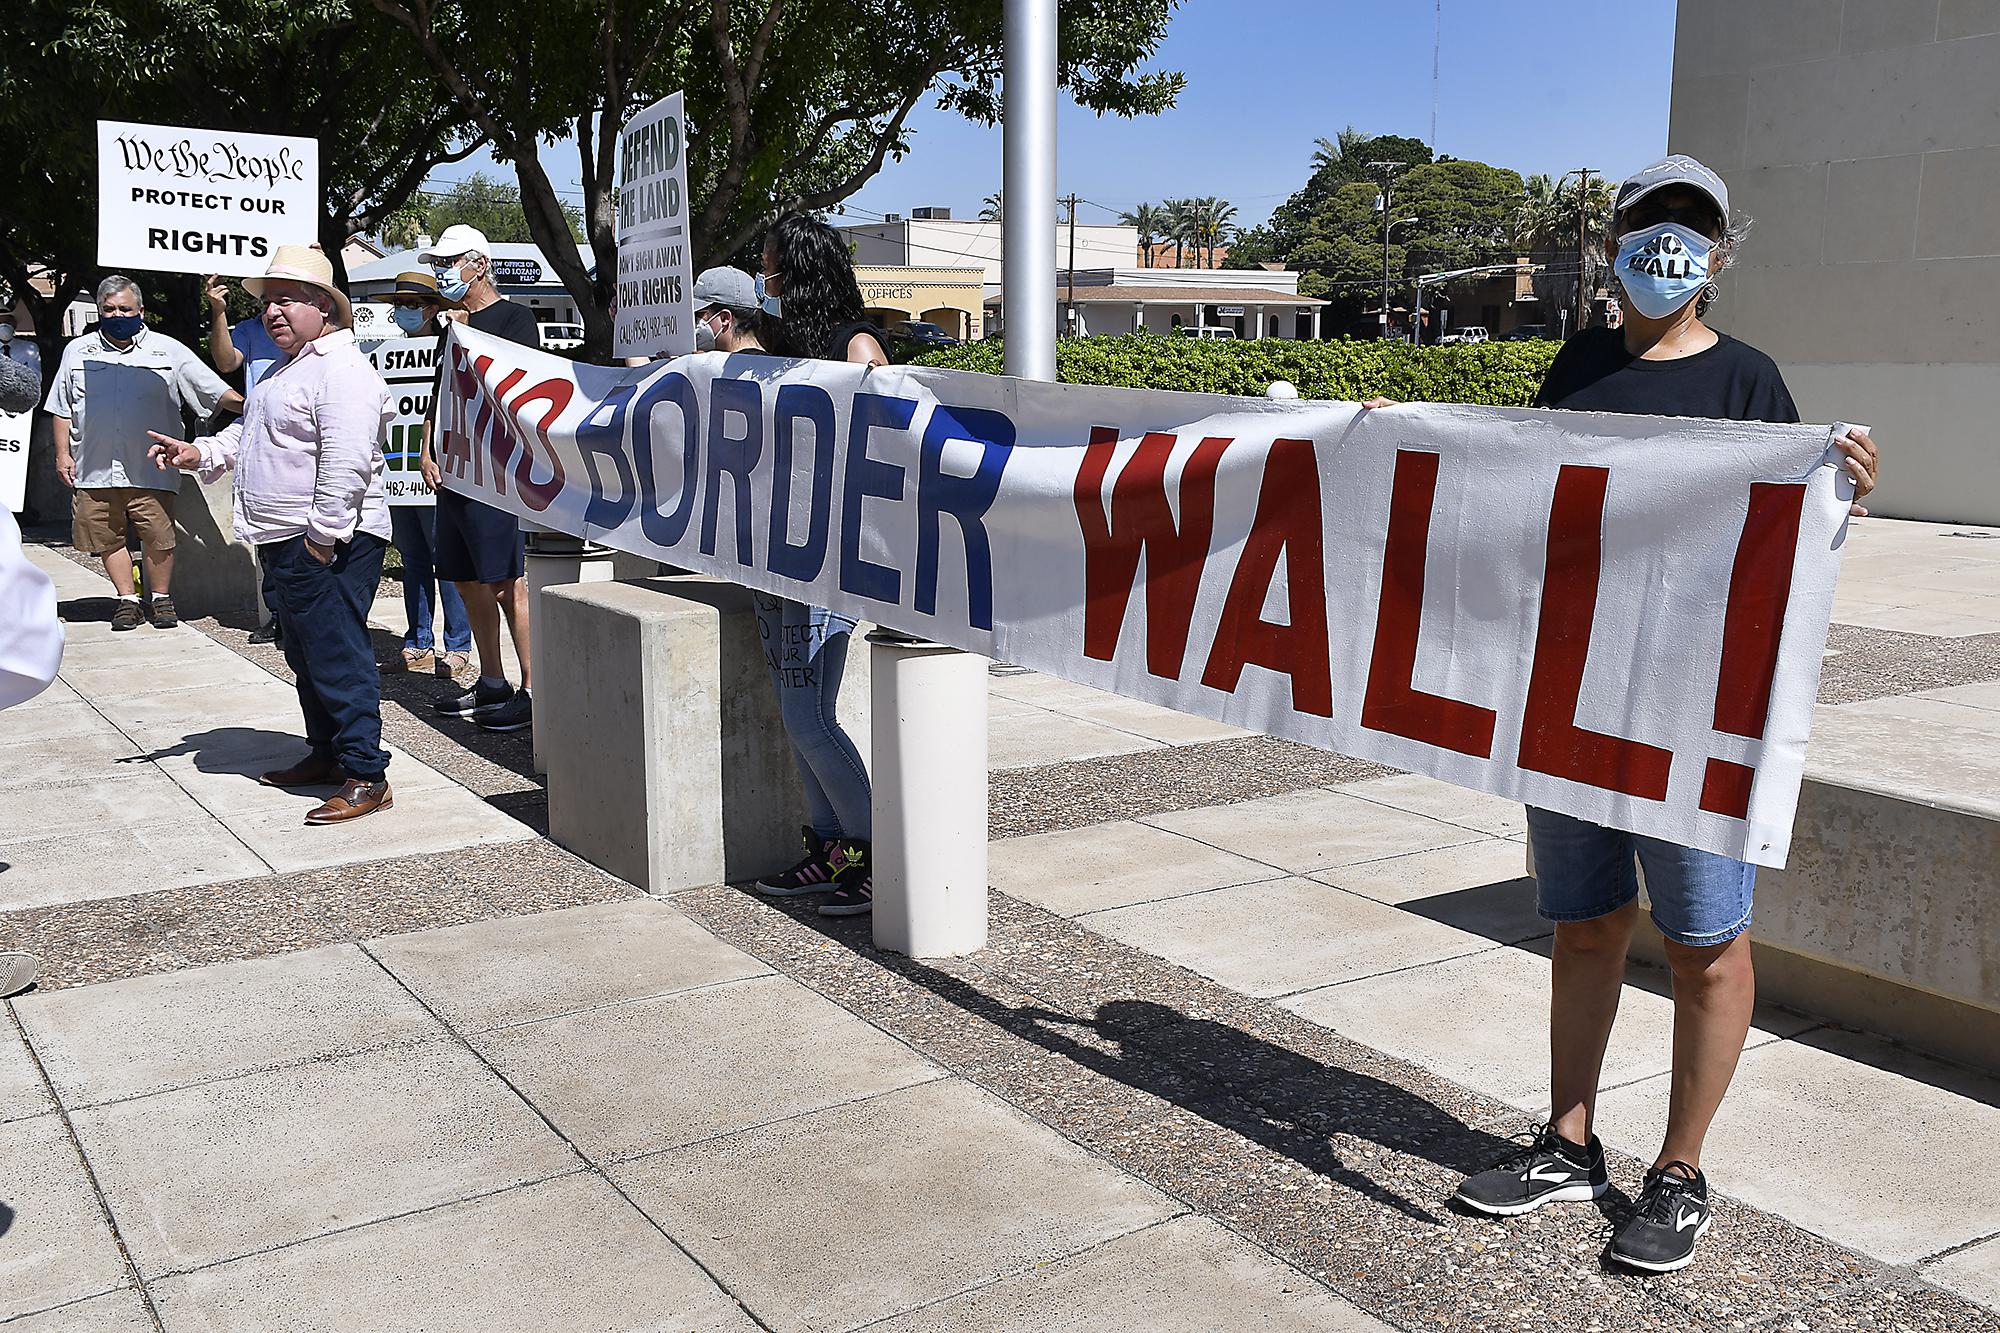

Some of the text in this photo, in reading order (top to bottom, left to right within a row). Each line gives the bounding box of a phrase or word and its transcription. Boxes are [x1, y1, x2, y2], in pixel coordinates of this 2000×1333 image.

[114, 131, 304, 191] We the People
[621, 116, 680, 187] DEFEND
[131, 187, 286, 215] PROTECT OUR
[640, 177, 680, 223] LAND
[148, 227, 268, 258] RIGHTS
[1643, 236, 1683, 255] NO
[636, 250, 653, 271] SIGN
[656, 245, 682, 268] AWAY
[1629, 257, 1691, 279] WALL
[511, 268, 541, 276] LOZANO
[619, 275, 682, 308] YOUR RIGHTS
[867, 288, 913, 299] OFFICES
[398, 396, 433, 416] OU
[0, 439, 21, 452] ES
[385, 481, 437, 497] 482-440
[575, 371, 1017, 631] BORDER
[1073, 426, 1807, 820] WALL!
